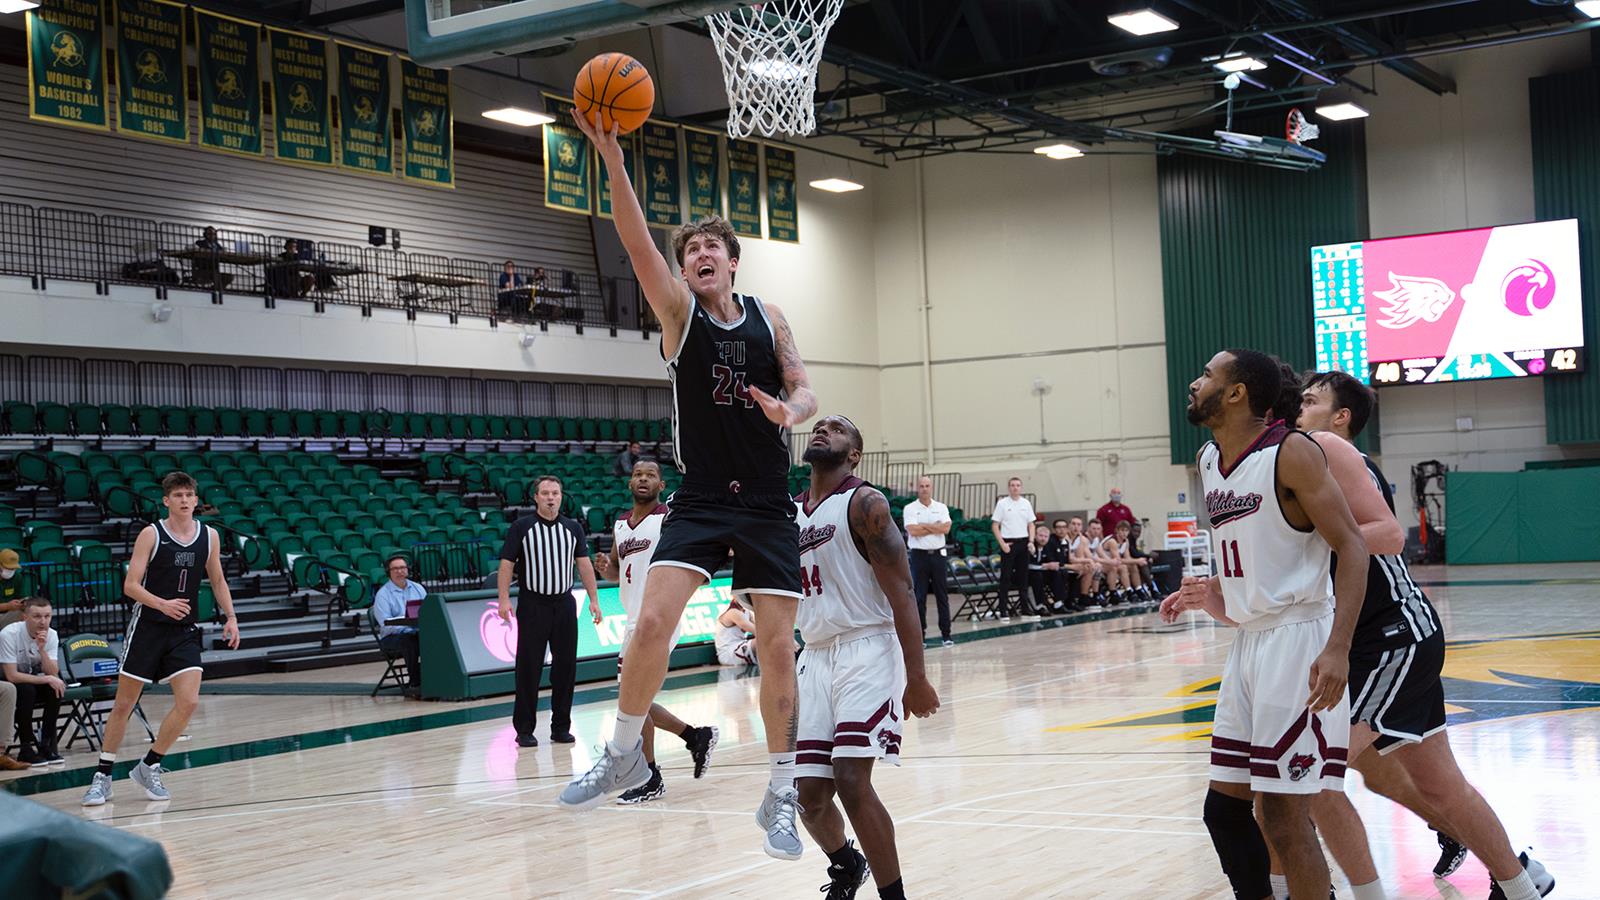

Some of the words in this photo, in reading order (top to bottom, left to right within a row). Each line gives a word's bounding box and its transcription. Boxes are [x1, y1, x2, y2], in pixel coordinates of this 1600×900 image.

[46, 70, 92, 91] WOMEN'S
[39, 86, 98, 107] BASKETBALL
[132, 87, 174, 105] WOMEN'S
[58, 105, 82, 120] 1982
[126, 102, 179, 122] BASKETBALL
[211, 103, 250, 121] WOMEN'S
[206, 116, 257, 137] BASKETBALL
[285, 117, 320, 133] WOMEN'S
[281, 131, 327, 148] BASKETBALL
[349, 127, 383, 144] WOMEN'S
[346, 140, 388, 158] BASKETBALL
[412, 140, 442, 156] WOMEN'S
[408, 153, 448, 169] BASKETBALL
[1550, 349, 1577, 370] 42
[1375, 361, 1401, 383] 40
[712, 364, 756, 409] 24
[1206, 488, 1263, 520] Wildcats
[174, 551, 196, 567] SPU
[1221, 540, 1245, 578] 11
[177, 568, 188, 593] 1
[625, 562, 633, 585] 4
[800, 564, 823, 598] 44
[70, 638, 109, 652] BRONCOS
